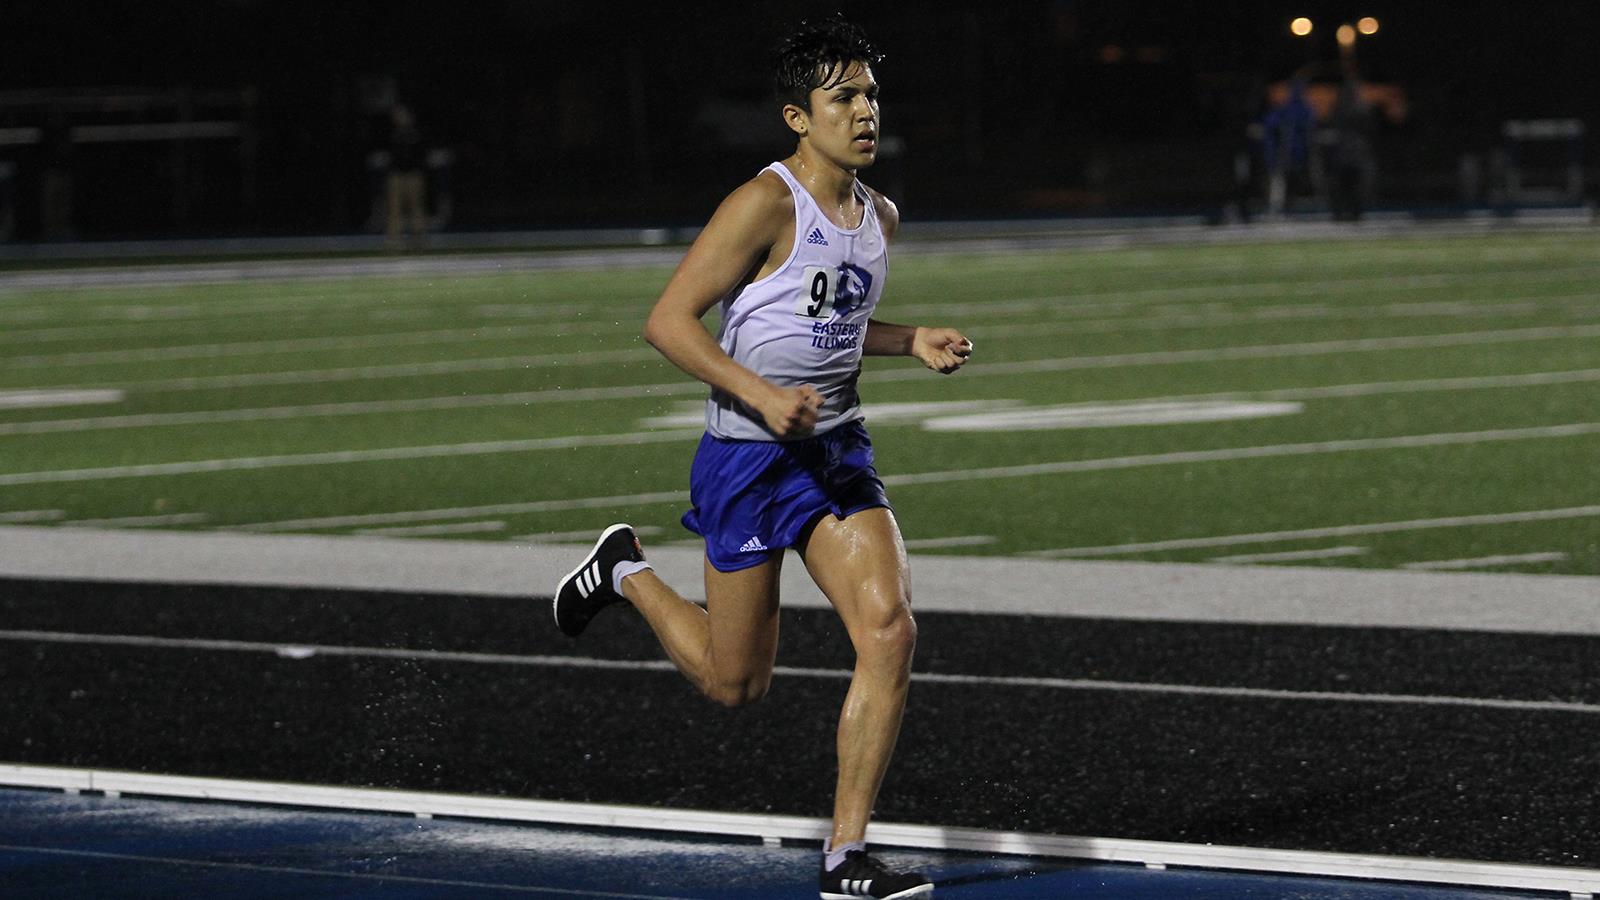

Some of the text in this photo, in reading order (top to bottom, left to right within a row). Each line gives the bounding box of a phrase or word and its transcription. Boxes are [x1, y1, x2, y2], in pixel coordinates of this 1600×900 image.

[807, 237, 829, 247] adidas
[807, 271, 828, 317] 9
[812, 322, 861, 336] EASTERN
[812, 335, 858, 350] ILLINOIS
